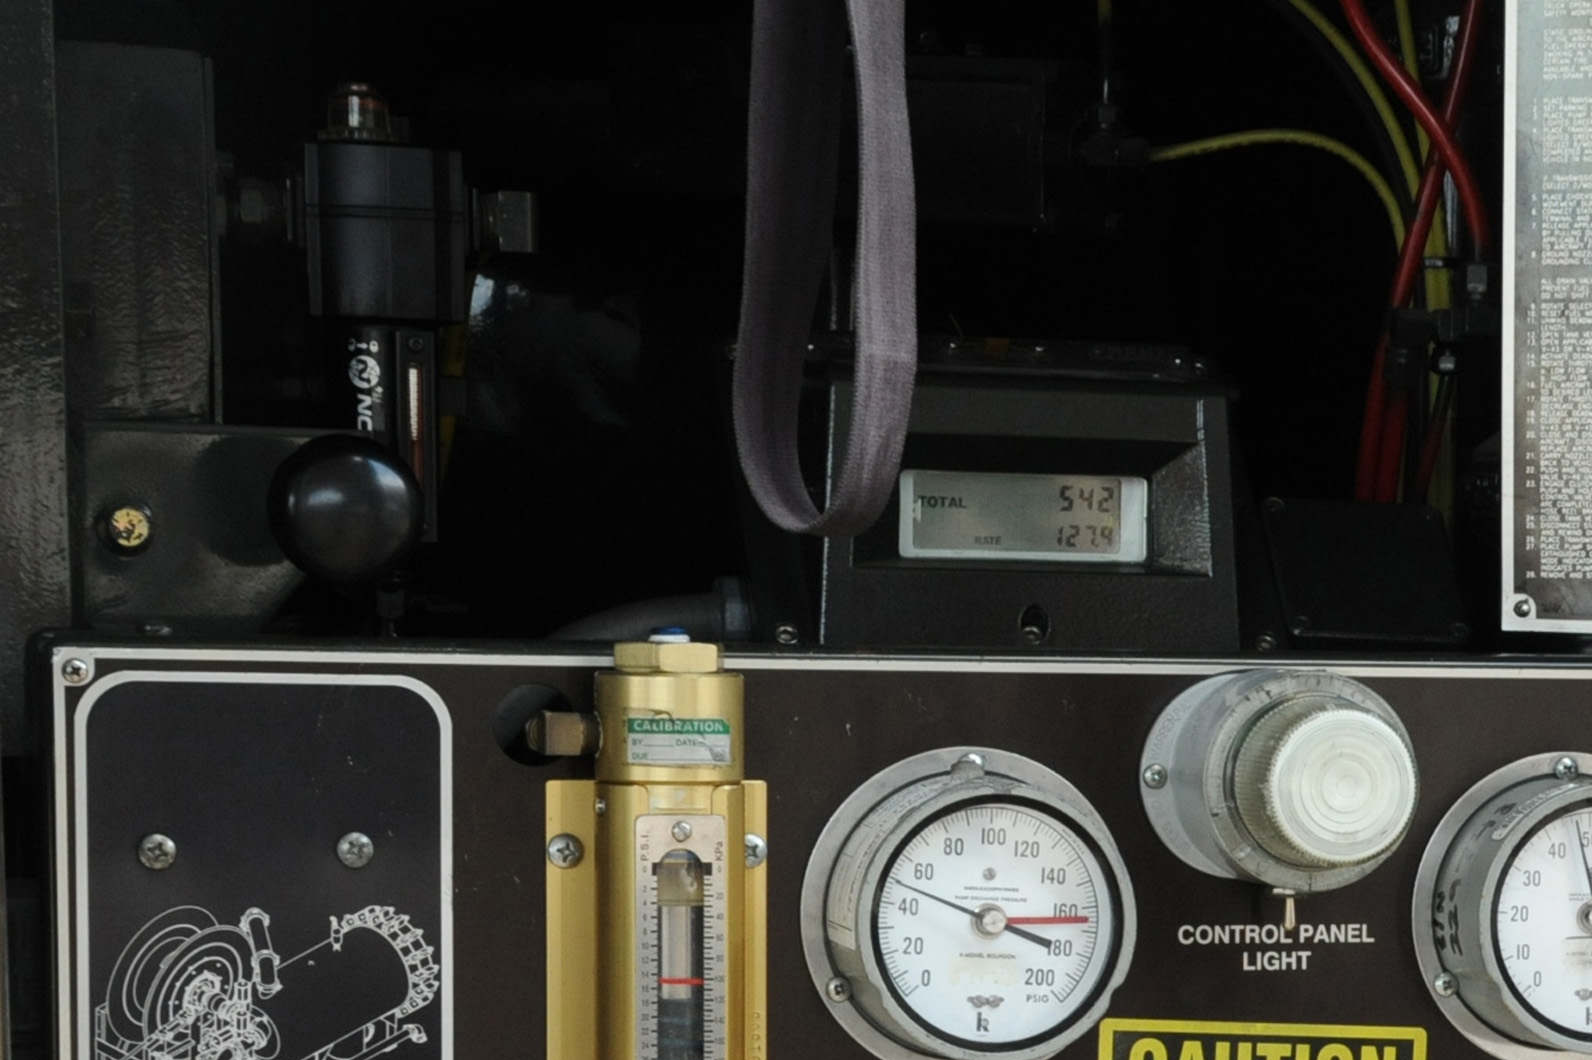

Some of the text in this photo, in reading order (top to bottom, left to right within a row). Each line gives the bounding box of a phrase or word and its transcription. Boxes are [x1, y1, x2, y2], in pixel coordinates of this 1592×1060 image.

[919, 485, 1114, 513] TOTAL 542
[974, 536, 1002, 546] RATE
[634, 720, 724, 733] CALIBRATION
[981, 827, 1006, 845] 100
[944, 838, 964, 856] 80
[1015, 841, 1039, 858] 120
[1548, 842, 1566, 859] 40
[914, 863, 933, 880] 60
[1041, 867, 1066, 885] 140
[1523, 870, 1541, 886] 30
[898, 898, 918, 915] 40
[1053, 904, 1078, 918] 160
[1511, 905, 1528, 922] 20
[1177, 924, 1374, 945] CONTROL PANEL
[903, 937, 923, 955] 20
[1517, 944, 1529, 960] 10
[1243, 951, 1311, 970] LIGHT
[922, 970, 930, 986] 0
[1025, 968, 1054, 986] 200
[1534, 971, 1541, 987] 0
[1026, 994, 1049, 1003] PSIG
